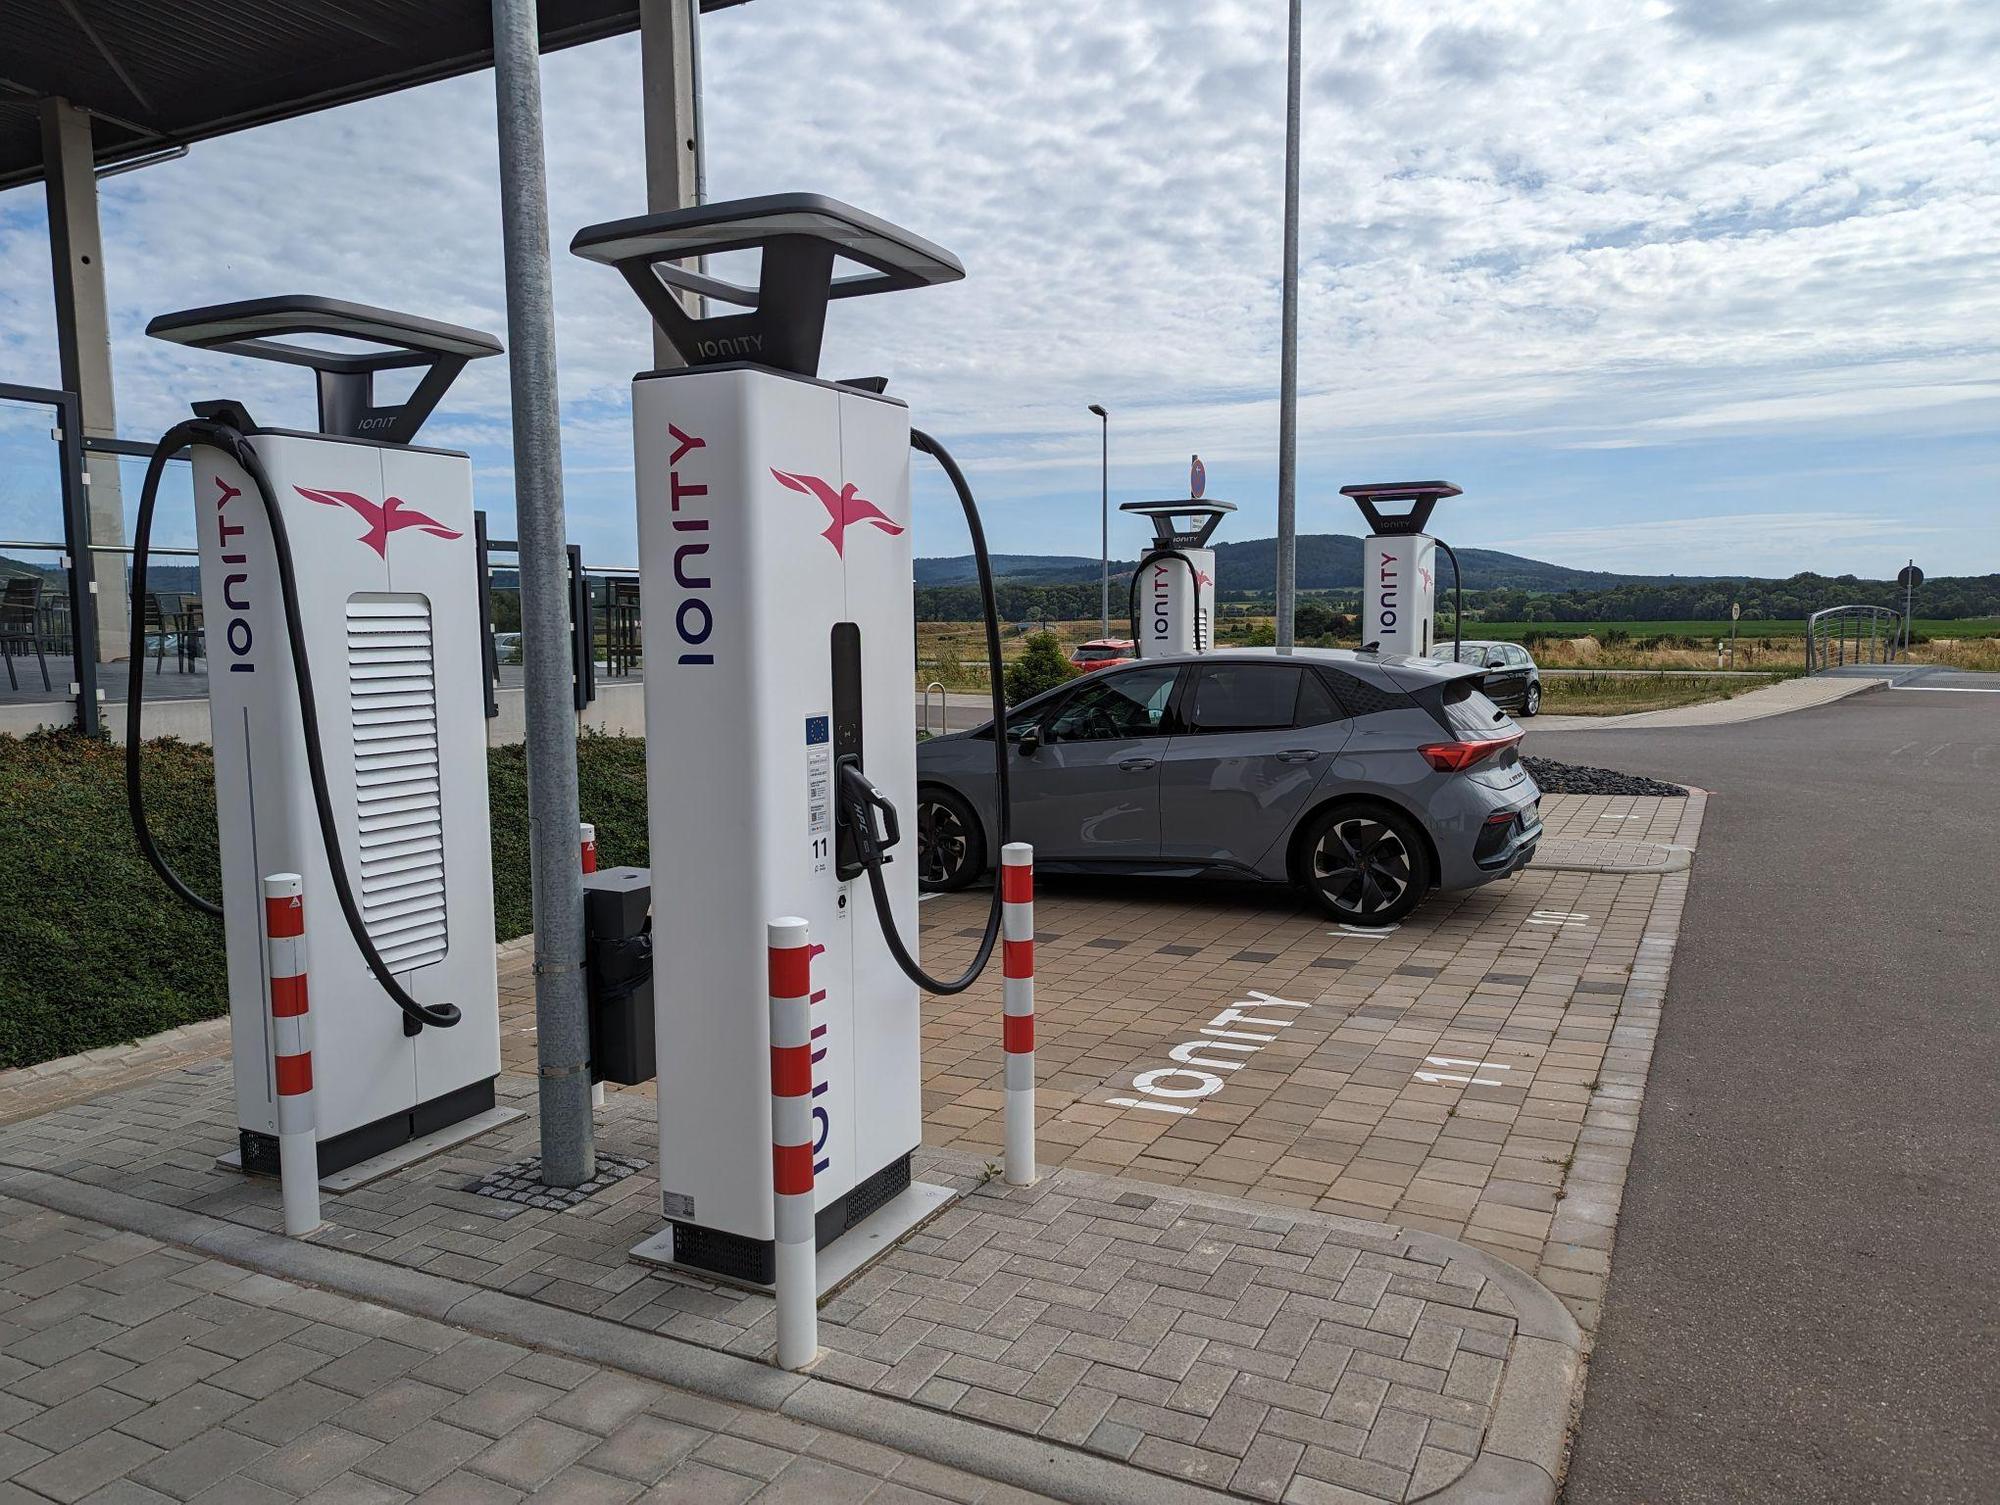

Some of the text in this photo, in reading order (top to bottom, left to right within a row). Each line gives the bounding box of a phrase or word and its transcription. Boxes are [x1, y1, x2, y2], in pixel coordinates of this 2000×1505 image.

[697, 333, 763, 358] IONITY
[669, 423, 714, 665] IONITY
[1380, 520, 1410, 528] IONITY
[215, 475, 255, 672] IONITY
[1380, 552, 1398, 634] IONITY
[1154, 563, 1169, 640] IONITY
[812, 837, 827, 859] 11
[1525, 910, 1591, 927] 10
[1104, 990, 1313, 1115] IONITY
[1413, 1056, 1511, 1087] 11
